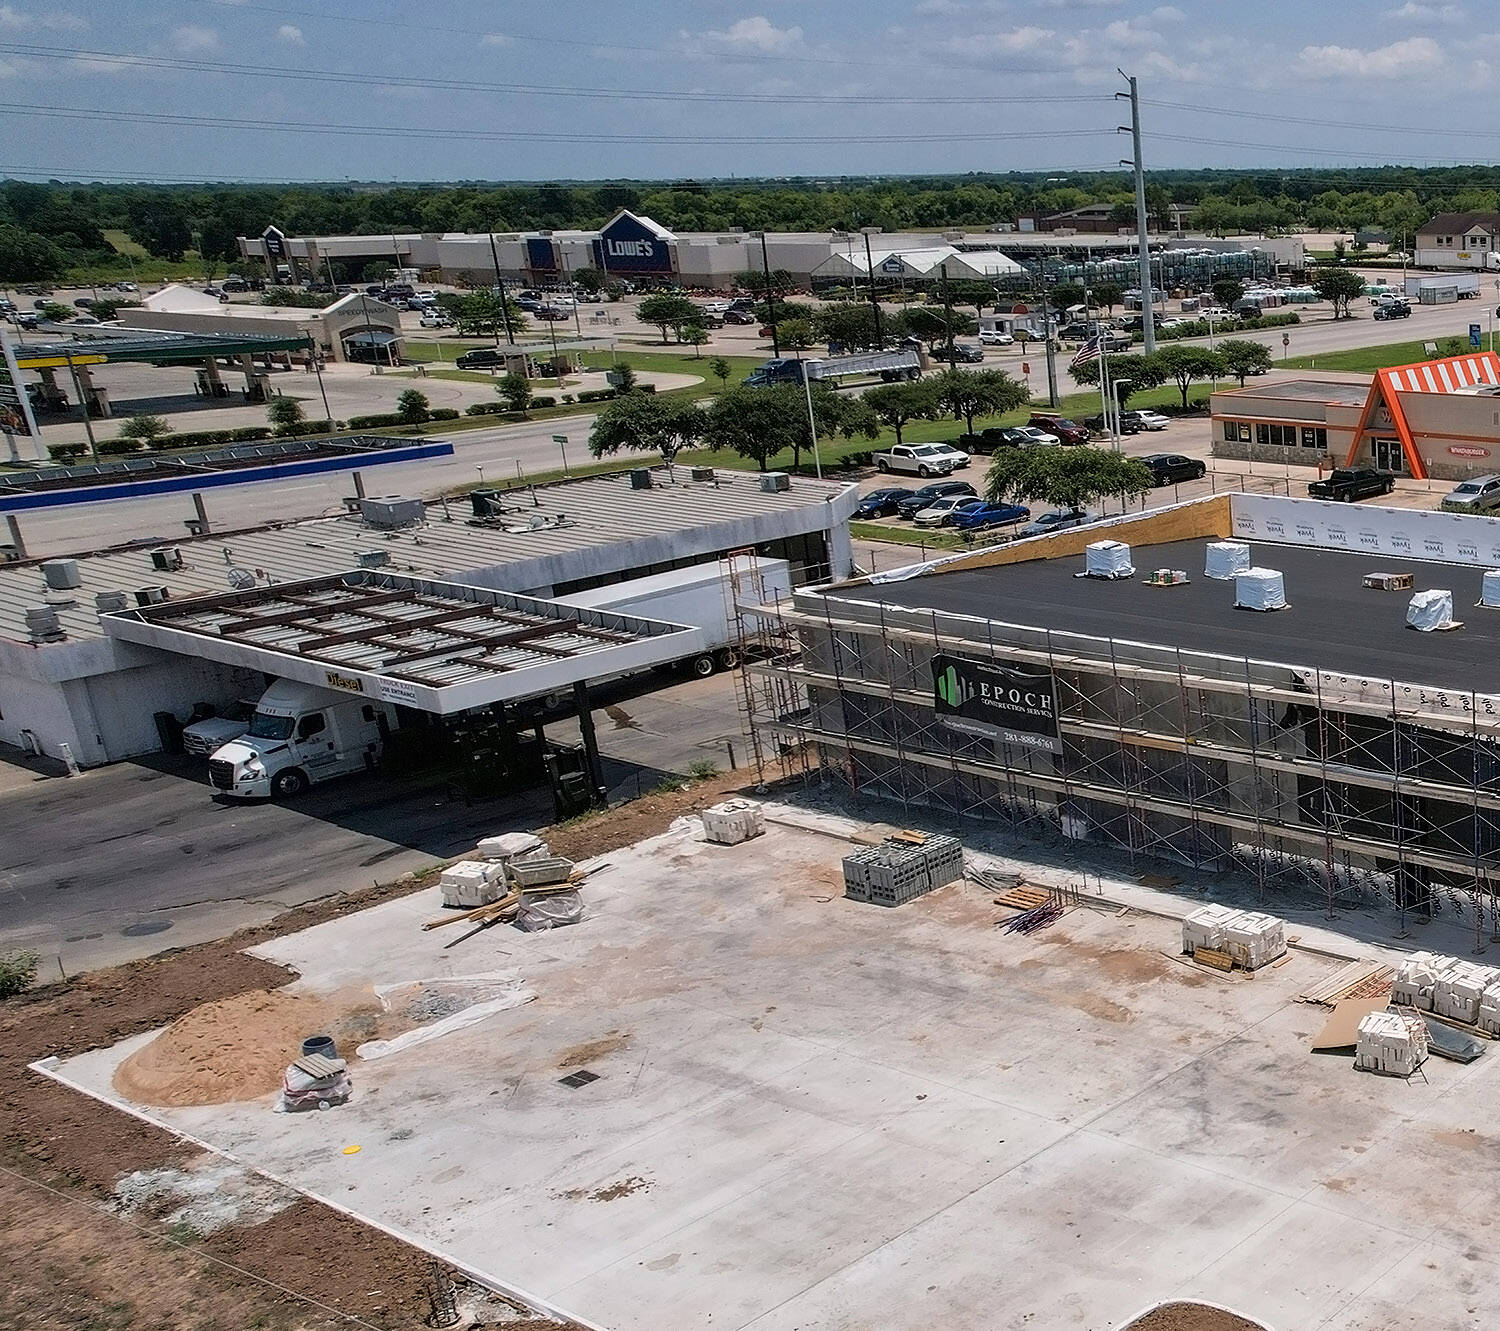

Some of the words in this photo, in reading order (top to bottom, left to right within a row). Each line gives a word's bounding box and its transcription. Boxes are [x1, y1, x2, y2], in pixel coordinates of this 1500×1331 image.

[607, 239, 653, 257] LOWE'S
[1424, 545, 1444, 553] Tyvek
[1458, 549, 1478, 557] Tyvek
[980, 682, 1052, 710] EPOCH
